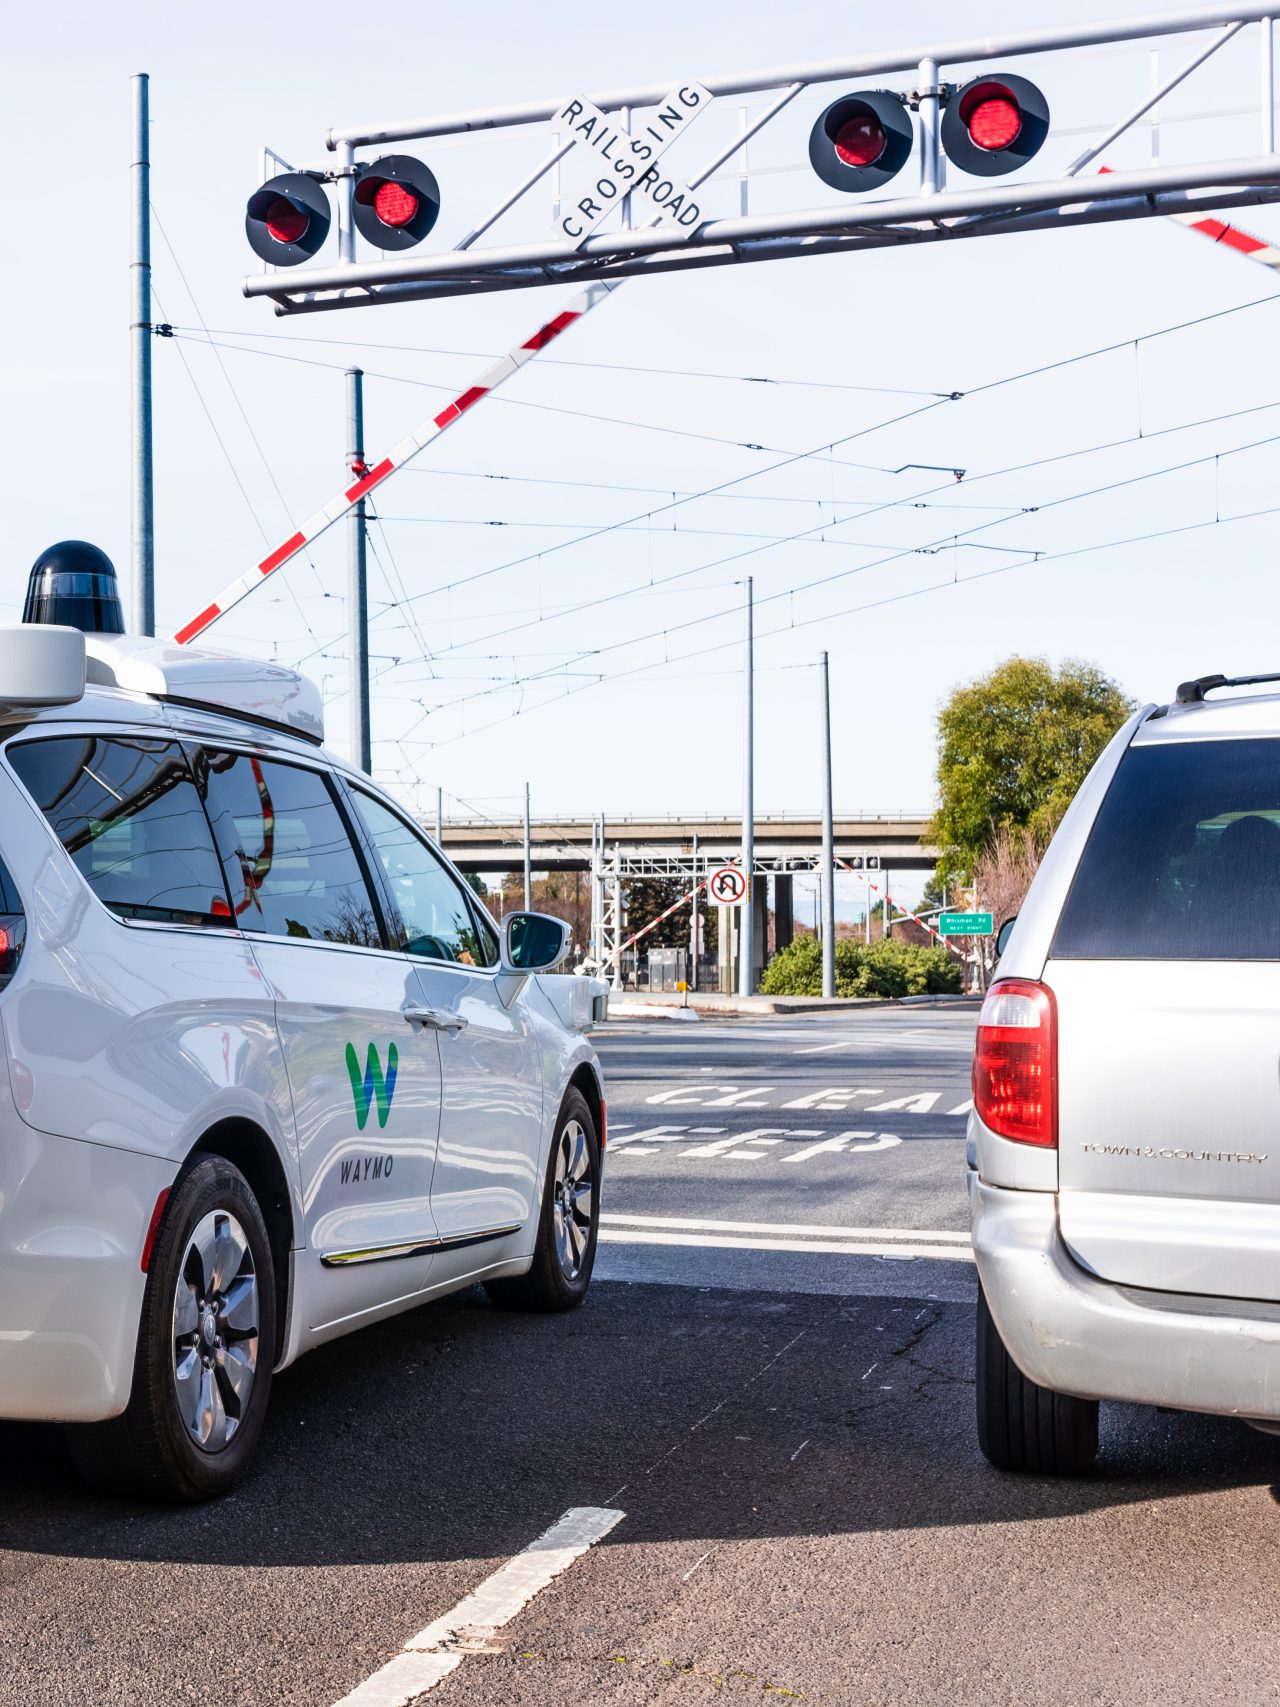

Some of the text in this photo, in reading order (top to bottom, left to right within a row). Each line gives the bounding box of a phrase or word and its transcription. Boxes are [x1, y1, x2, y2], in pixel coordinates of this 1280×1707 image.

[561, 99, 700, 226] RAIL ROAD
[562, 87, 700, 238] CROSSING
[341, 1154, 394, 1185] WAYMO
[606, 1124, 904, 1162] EEP
